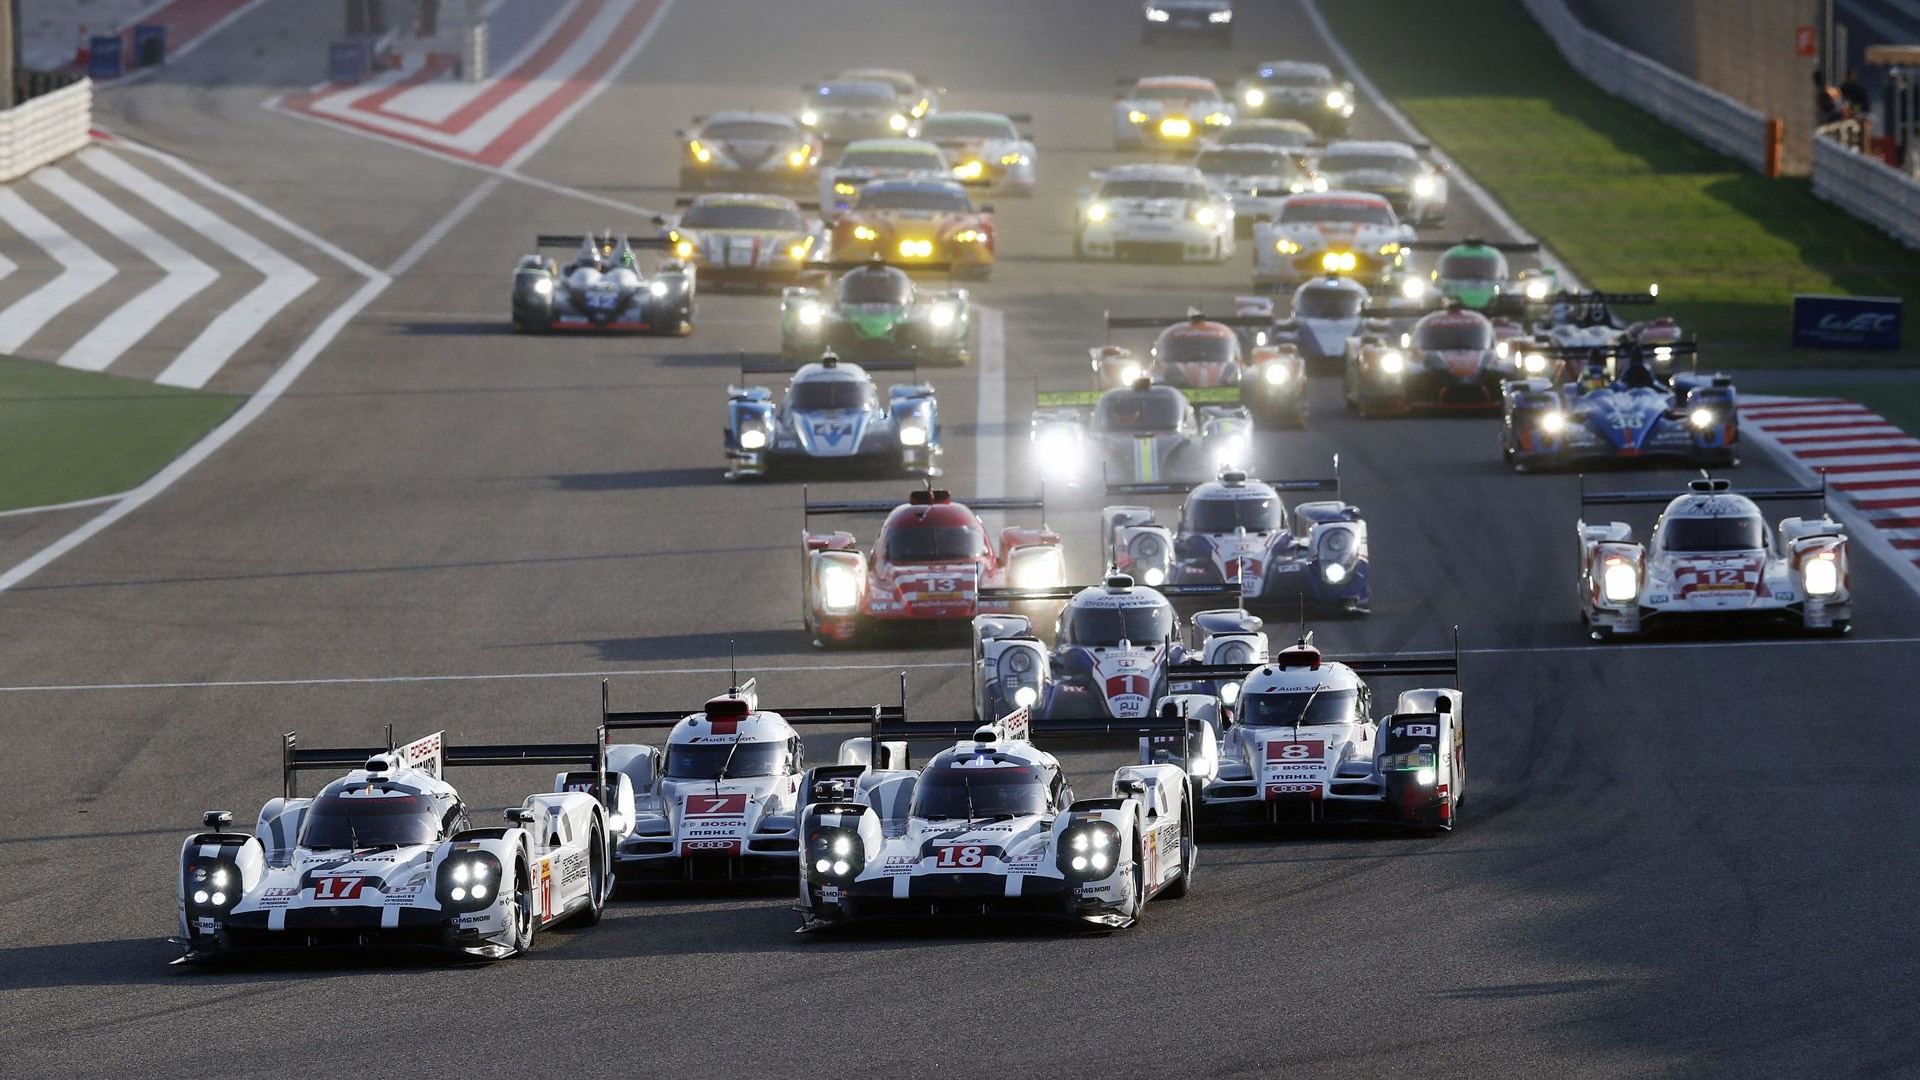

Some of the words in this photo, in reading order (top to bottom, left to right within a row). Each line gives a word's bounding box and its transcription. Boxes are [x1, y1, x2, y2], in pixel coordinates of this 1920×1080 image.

[1703, 569, 1738, 583] 12
[922, 579, 957, 592] 13
[1121, 676, 1134, 693] 1
[1304, 685, 1333, 693] Sport
[1411, 726, 1432, 735] P1
[1281, 744, 1310, 759] 8
[703, 798, 729, 813] 7
[938, 846, 982, 866] 18
[317, 877, 362, 898] 17
[1074, 887, 1094, 895] DMG
[472, 914, 491, 922] MORI
